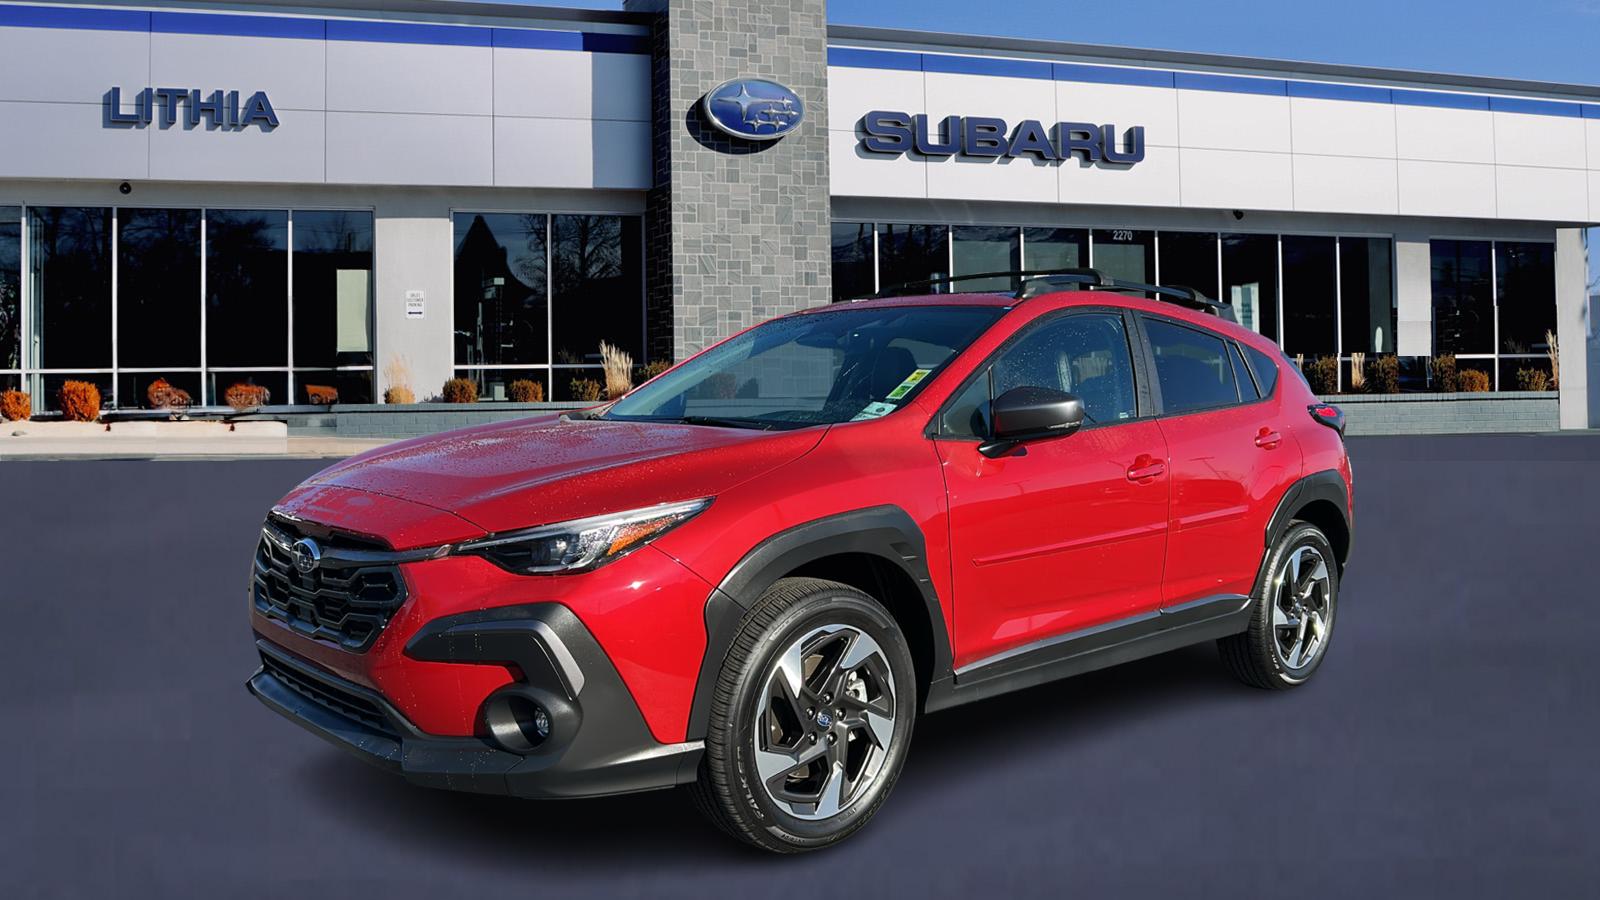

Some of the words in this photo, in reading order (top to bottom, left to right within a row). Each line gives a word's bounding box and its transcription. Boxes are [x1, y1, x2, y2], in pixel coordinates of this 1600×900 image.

[109, 86, 280, 127] LITHIA
[861, 109, 1145, 164] SUBARU
[1112, 230, 1133, 241] 2270
